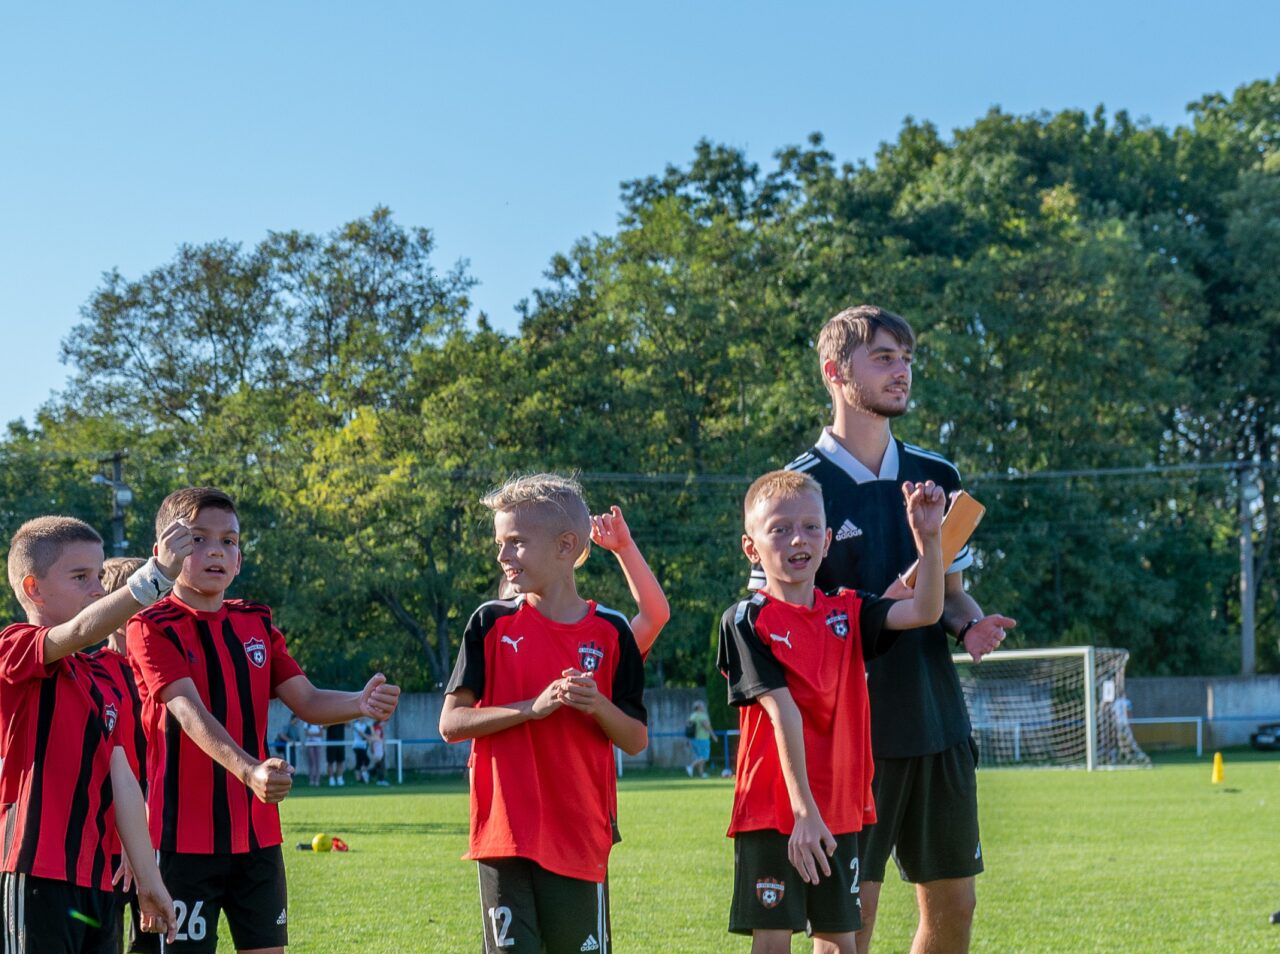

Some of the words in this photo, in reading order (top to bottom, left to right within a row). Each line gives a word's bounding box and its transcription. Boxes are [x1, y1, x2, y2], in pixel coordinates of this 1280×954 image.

[835, 528, 863, 541] adidas
[176, 900, 206, 941] 26
[488, 906, 515, 946] 12
[580, 943, 599, 952] adidas
